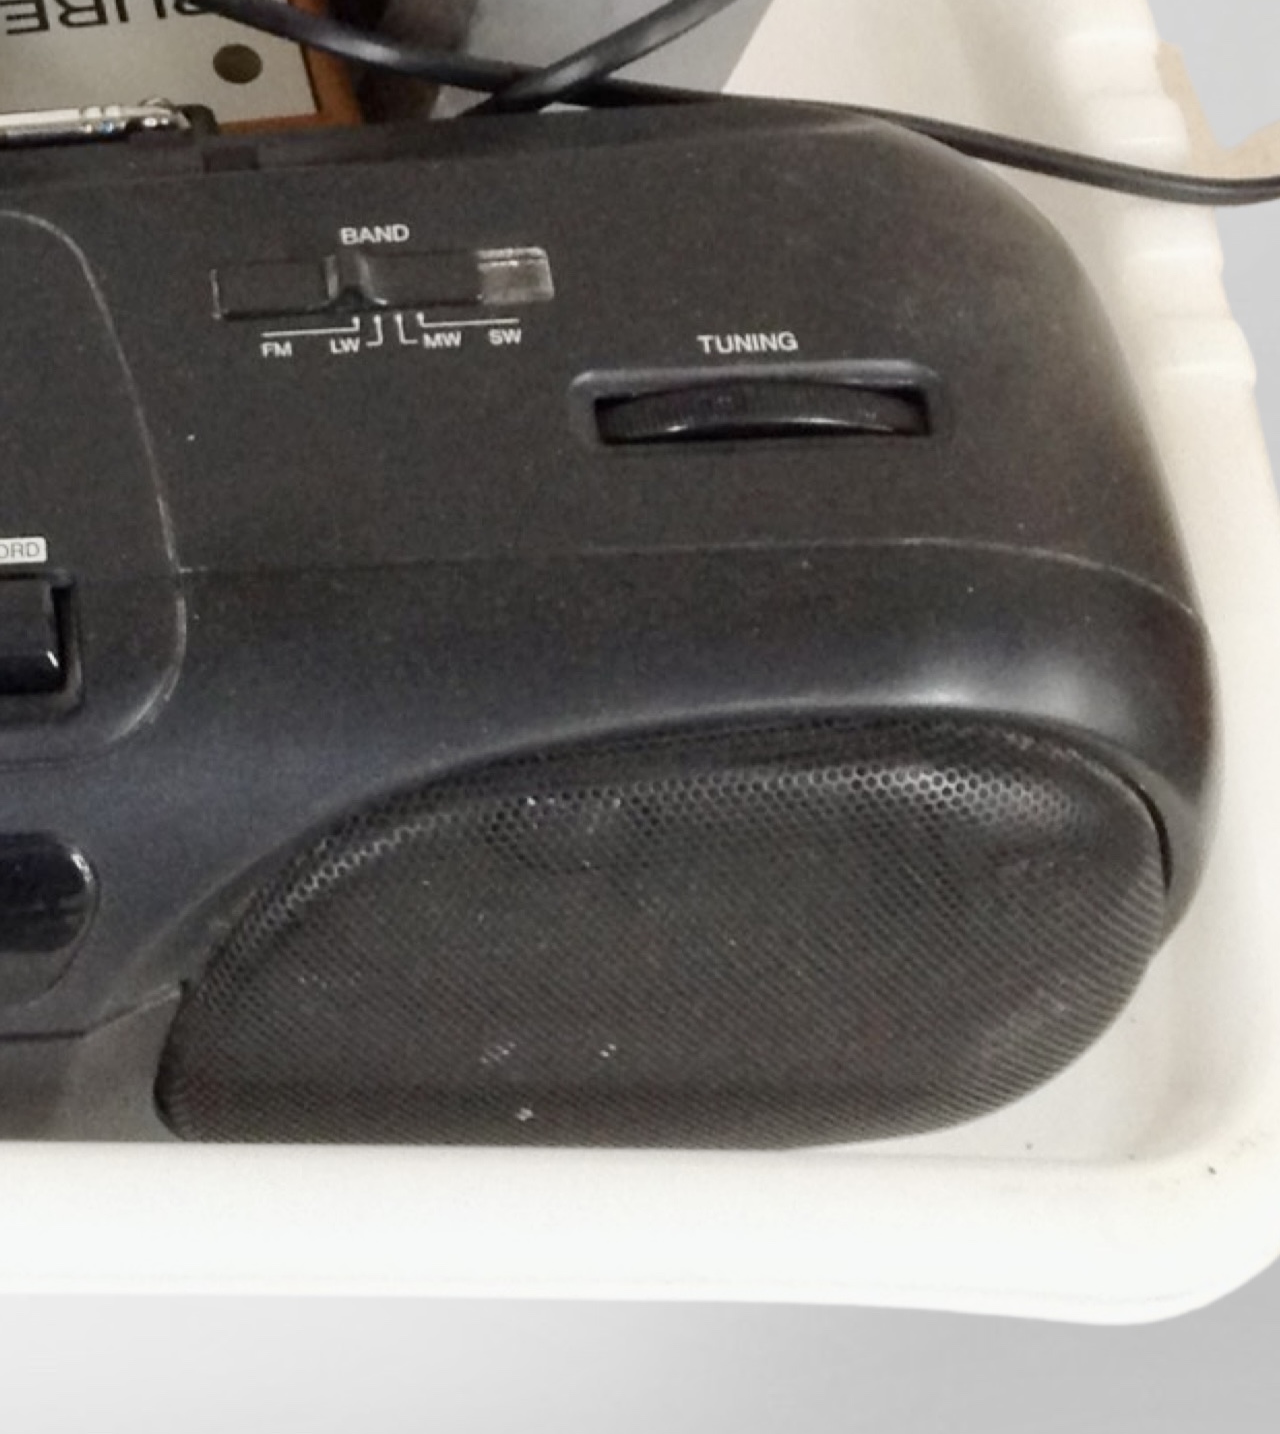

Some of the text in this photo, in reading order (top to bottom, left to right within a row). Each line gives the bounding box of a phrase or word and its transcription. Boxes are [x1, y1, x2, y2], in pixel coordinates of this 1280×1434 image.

[340, 224, 410, 245] BAND
[261, 328, 522, 357] FM LW MW SW
[696, 331, 798, 354] TUNING
